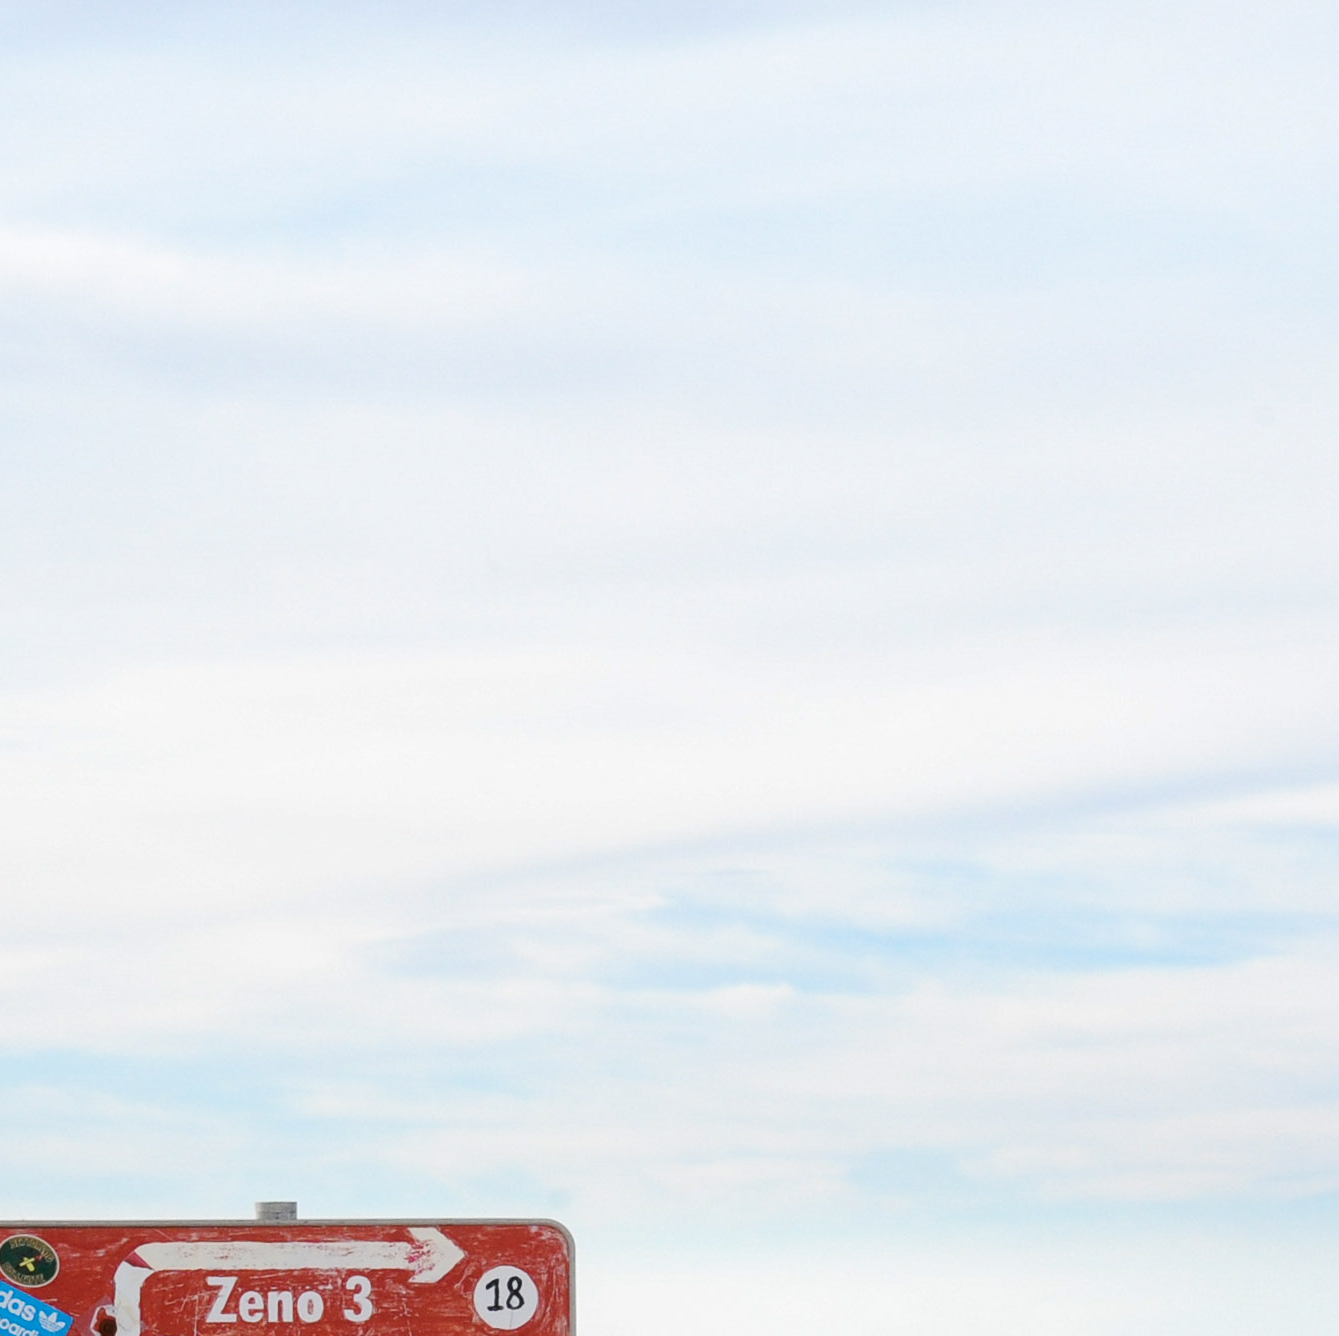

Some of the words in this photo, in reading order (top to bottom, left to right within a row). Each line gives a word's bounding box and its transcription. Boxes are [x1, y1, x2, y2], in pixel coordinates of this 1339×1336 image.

[205, 1275, 324, 1323] Zeno
[344, 1275, 373, 1322] 3
[484, 1275, 525, 1312] 18
